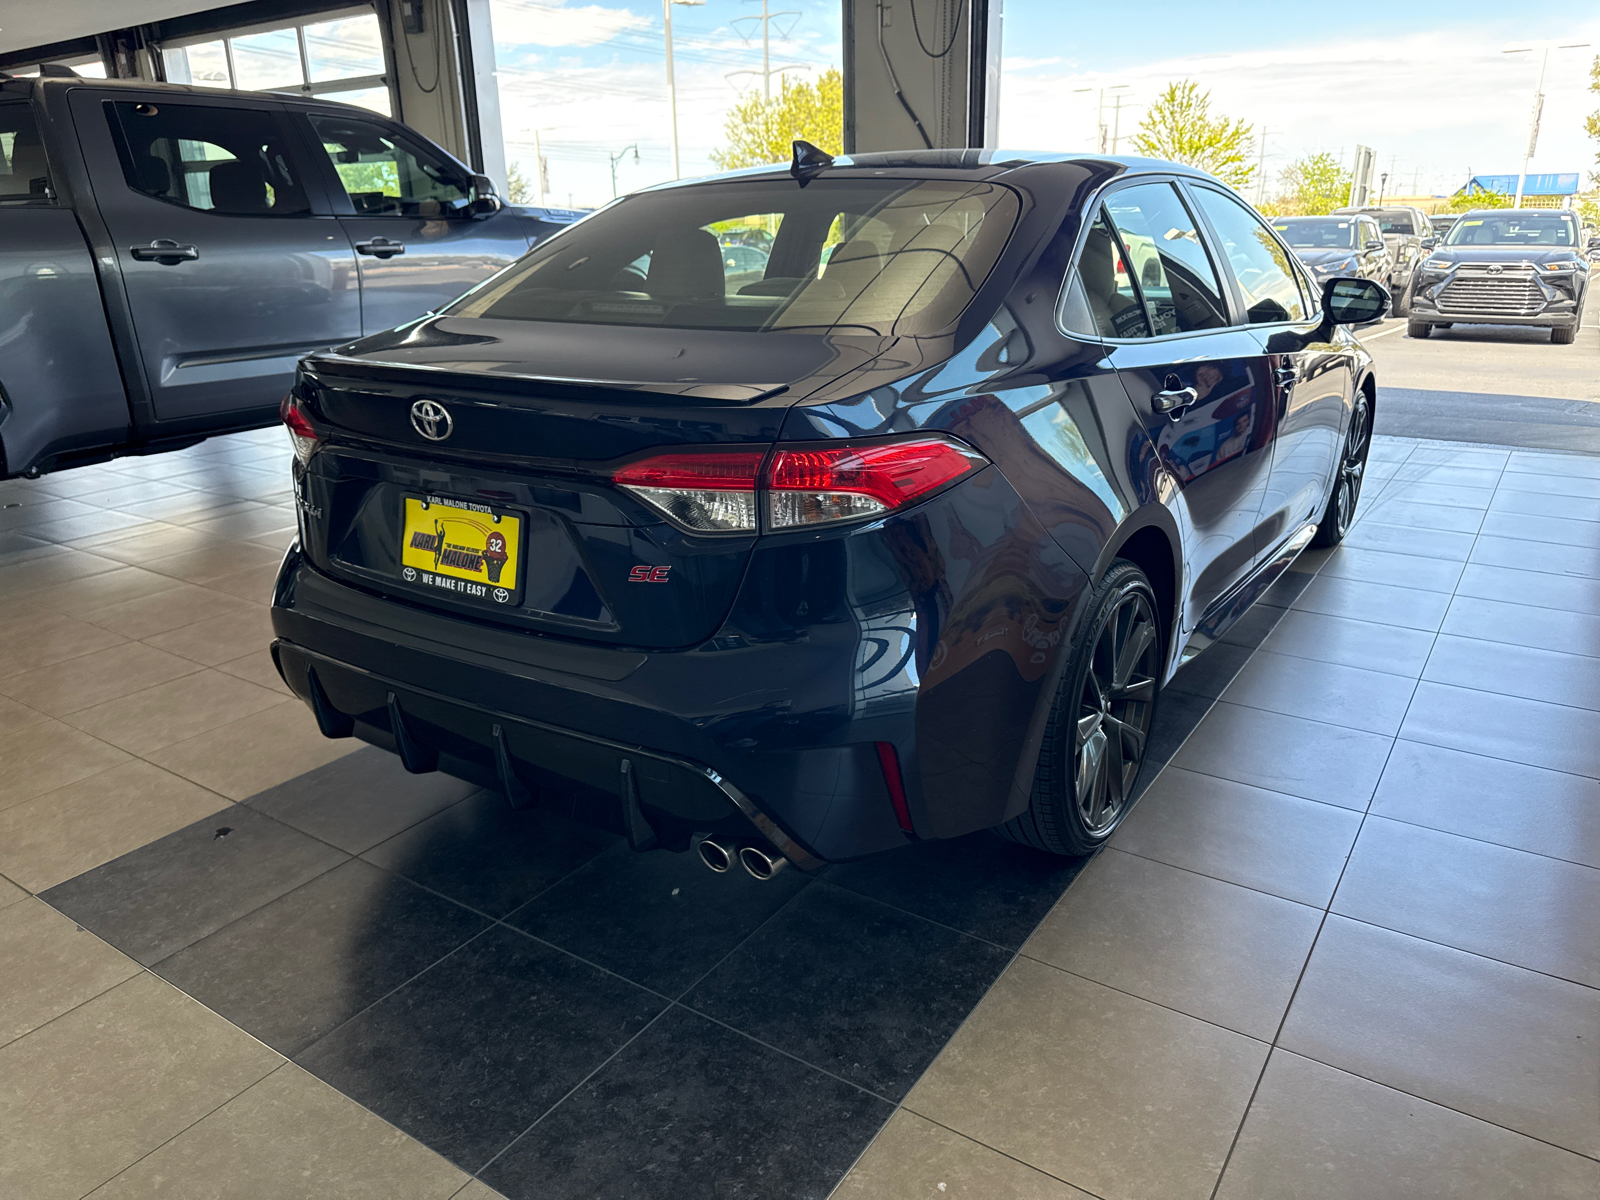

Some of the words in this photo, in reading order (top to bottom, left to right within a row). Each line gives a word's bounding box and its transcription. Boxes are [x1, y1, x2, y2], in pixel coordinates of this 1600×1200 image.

[426, 495, 442, 506] KARL
[443, 498, 468, 510] MALONE
[468, 502, 492, 514] TOYOTA
[410, 531, 437, 552] KARL
[490, 538, 502, 552] 32
[440, 548, 484, 573] MALONE
[628, 565, 672, 582] SE
[422, 572, 433, 585] WE
[435, 575, 455, 590] MAKE
[458, 581, 465, 592] IT
[466, 584, 487, 597] EASY
